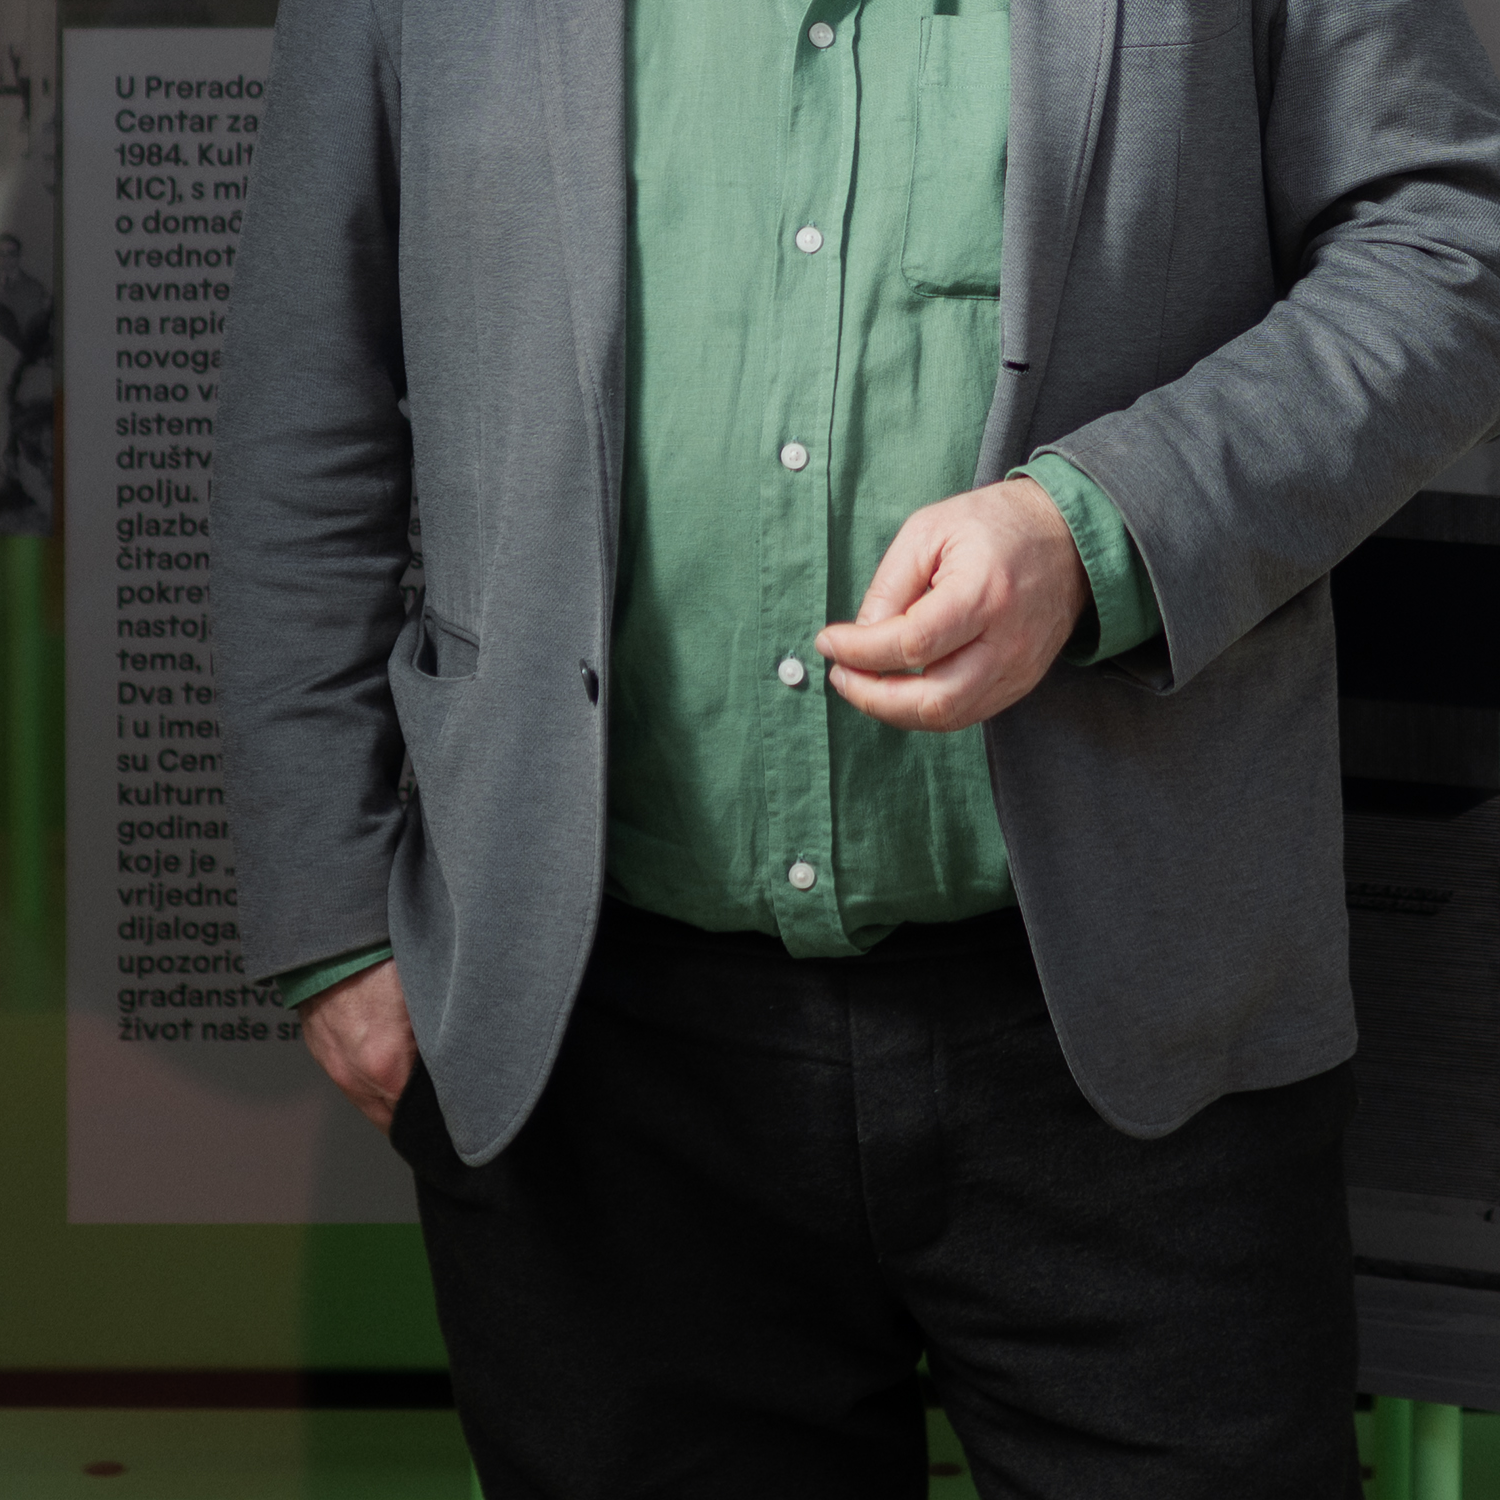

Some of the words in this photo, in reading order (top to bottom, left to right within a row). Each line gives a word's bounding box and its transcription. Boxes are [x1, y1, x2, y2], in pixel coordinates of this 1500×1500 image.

[115, 75, 135, 99] U
[145, 75, 267, 99] Prerado
[115, 109, 218, 133] Centar
[226, 114, 259, 133] za
[115, 143, 189, 167] 1984.
[191, 182, 205, 200] s
[115, 216, 133, 234] o
[116, 316, 150, 335] na
[116, 378, 189, 401] imao
[117, 479, 199, 508] polju.
[117, 682, 173, 706] Dva
[117, 753, 148, 772] su
[118, 849, 180, 879] koje
[188, 849, 216, 879] je
[118, 1017, 193, 1042] život
[200, 1017, 269, 1042] naše
